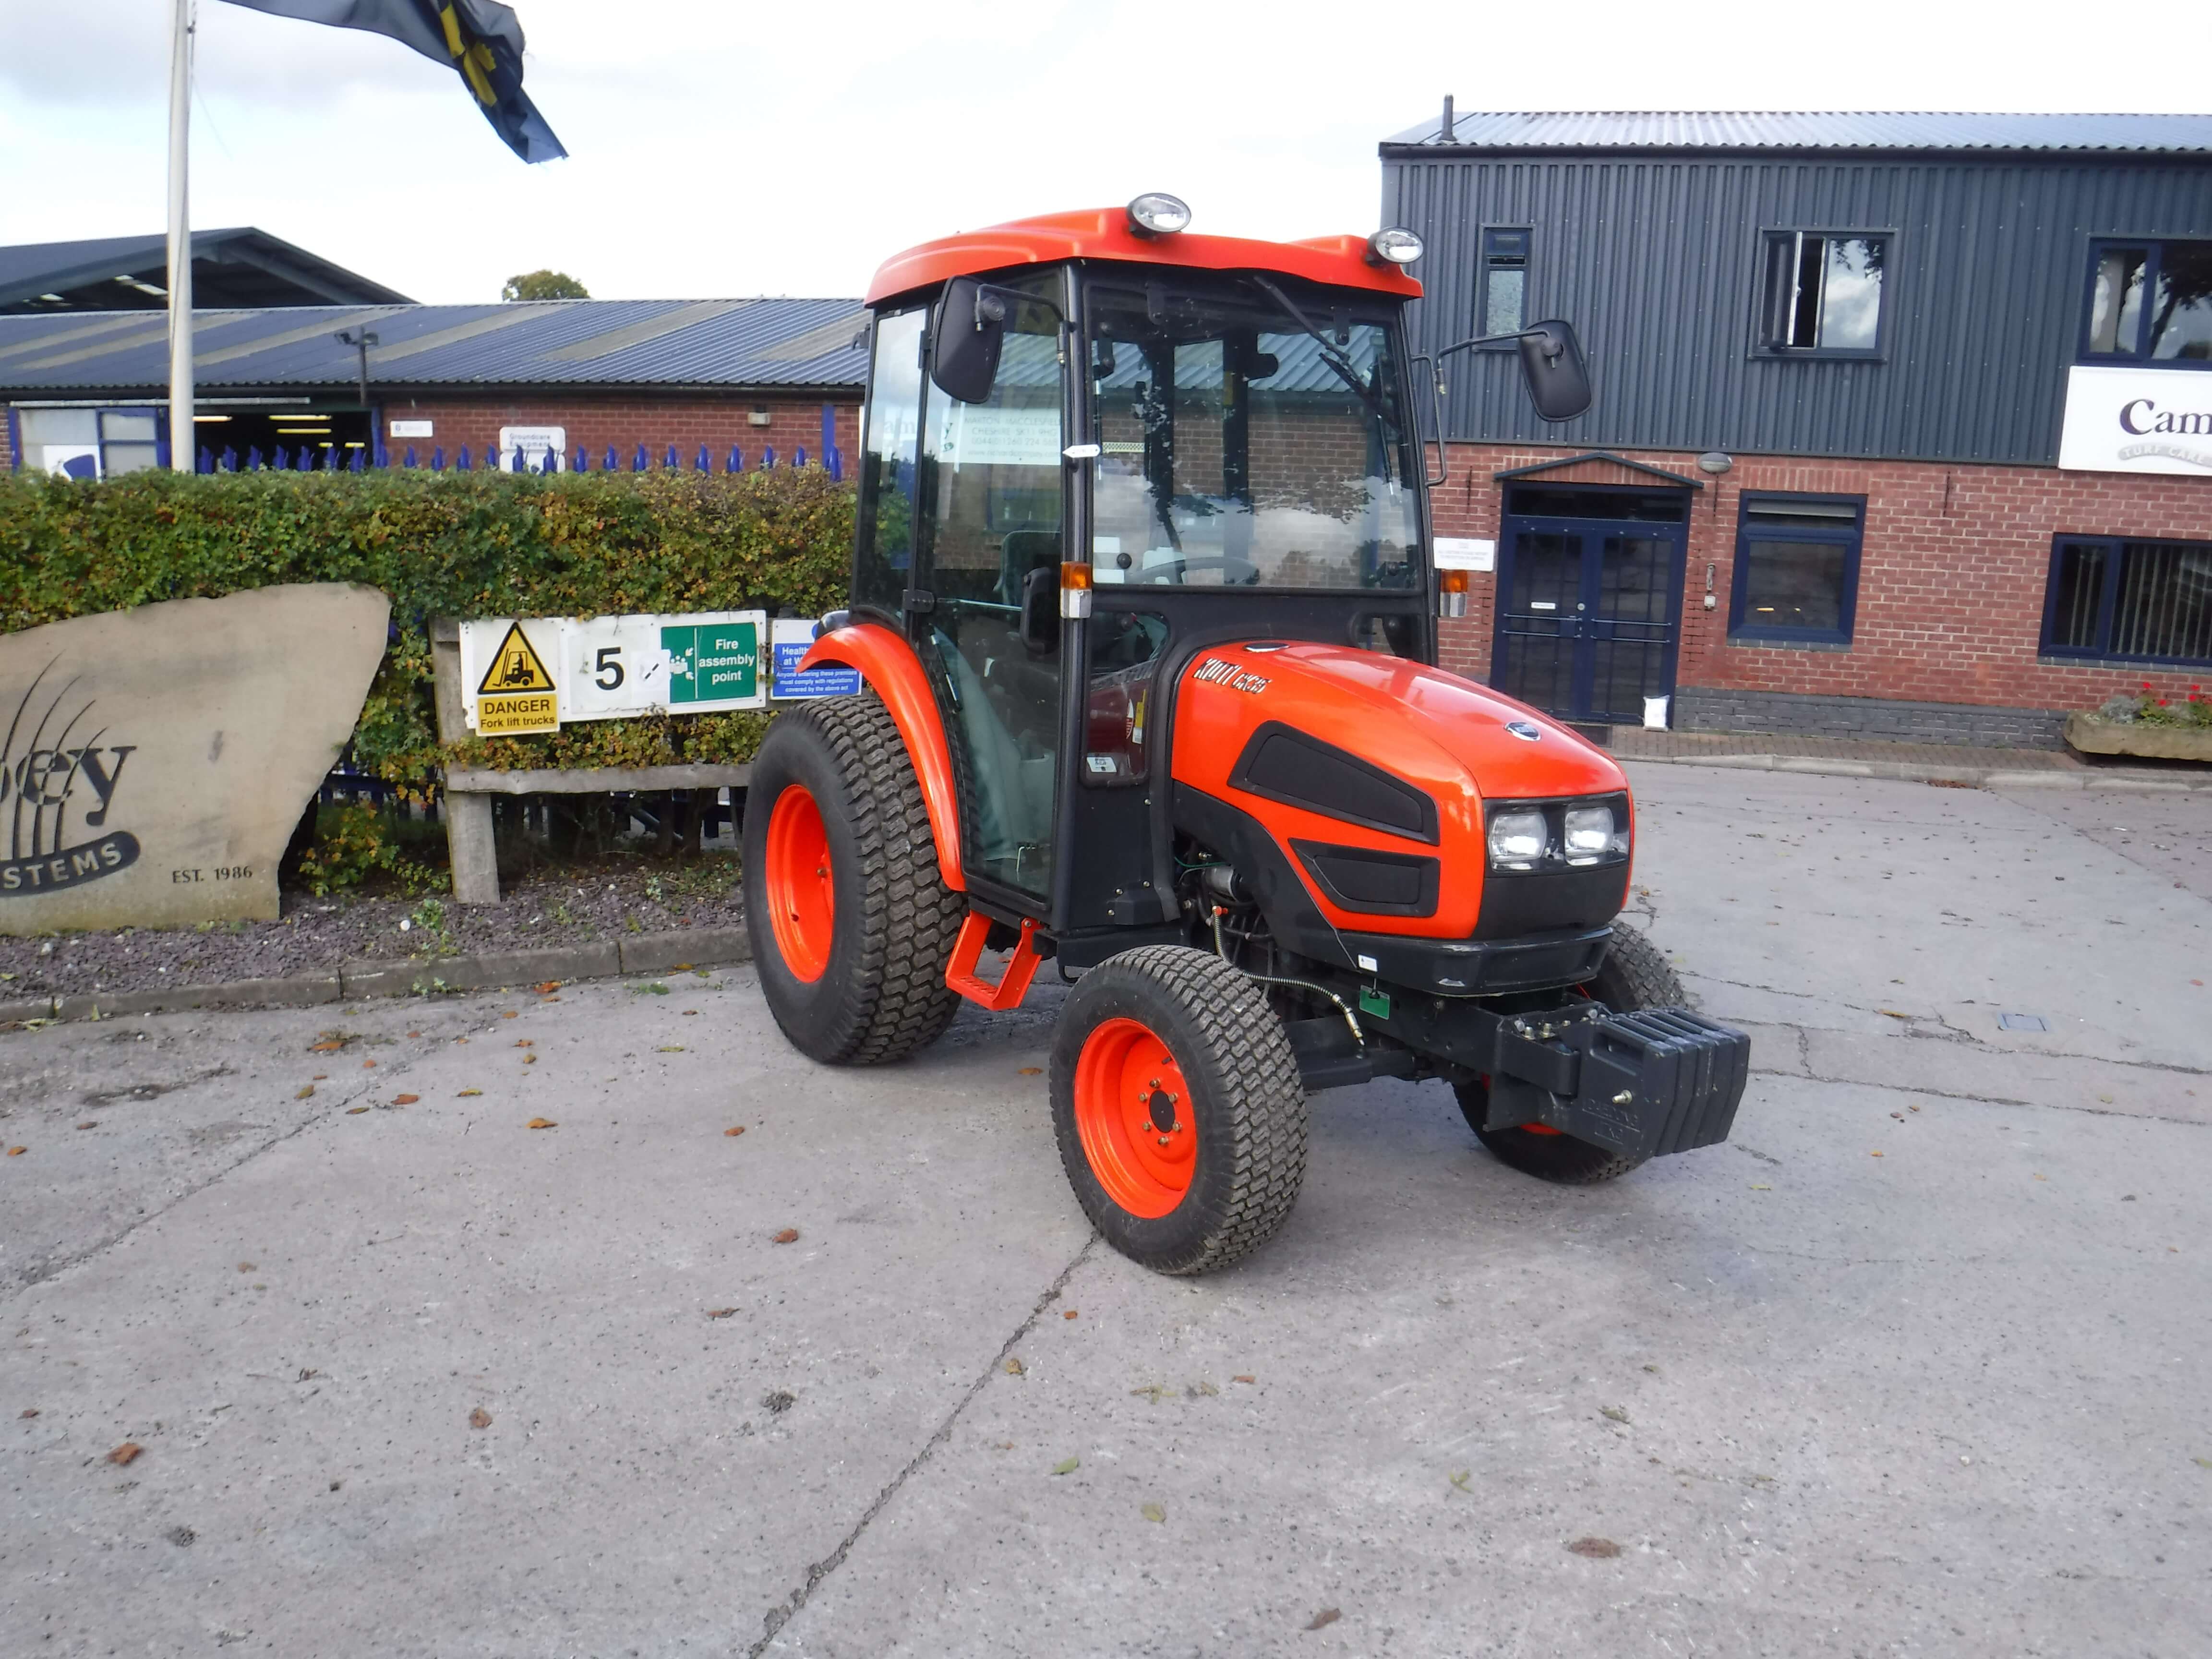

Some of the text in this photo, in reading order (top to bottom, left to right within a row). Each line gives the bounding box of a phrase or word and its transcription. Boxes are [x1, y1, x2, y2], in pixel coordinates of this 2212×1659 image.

[2125, 445, 2205, 462] TURF CARE
[715, 638, 738, 650] Fire
[698, 653, 755, 667] assembly
[783, 657, 792, 665] at
[595, 646, 625, 691] 5
[712, 670, 742, 685] point
[485, 699, 550, 715] DANGER
[481, 716, 555, 728] Fork lift trucks
[2, 842, 122, 889] STEMS
[172, 866, 252, 883] EST. 1986
